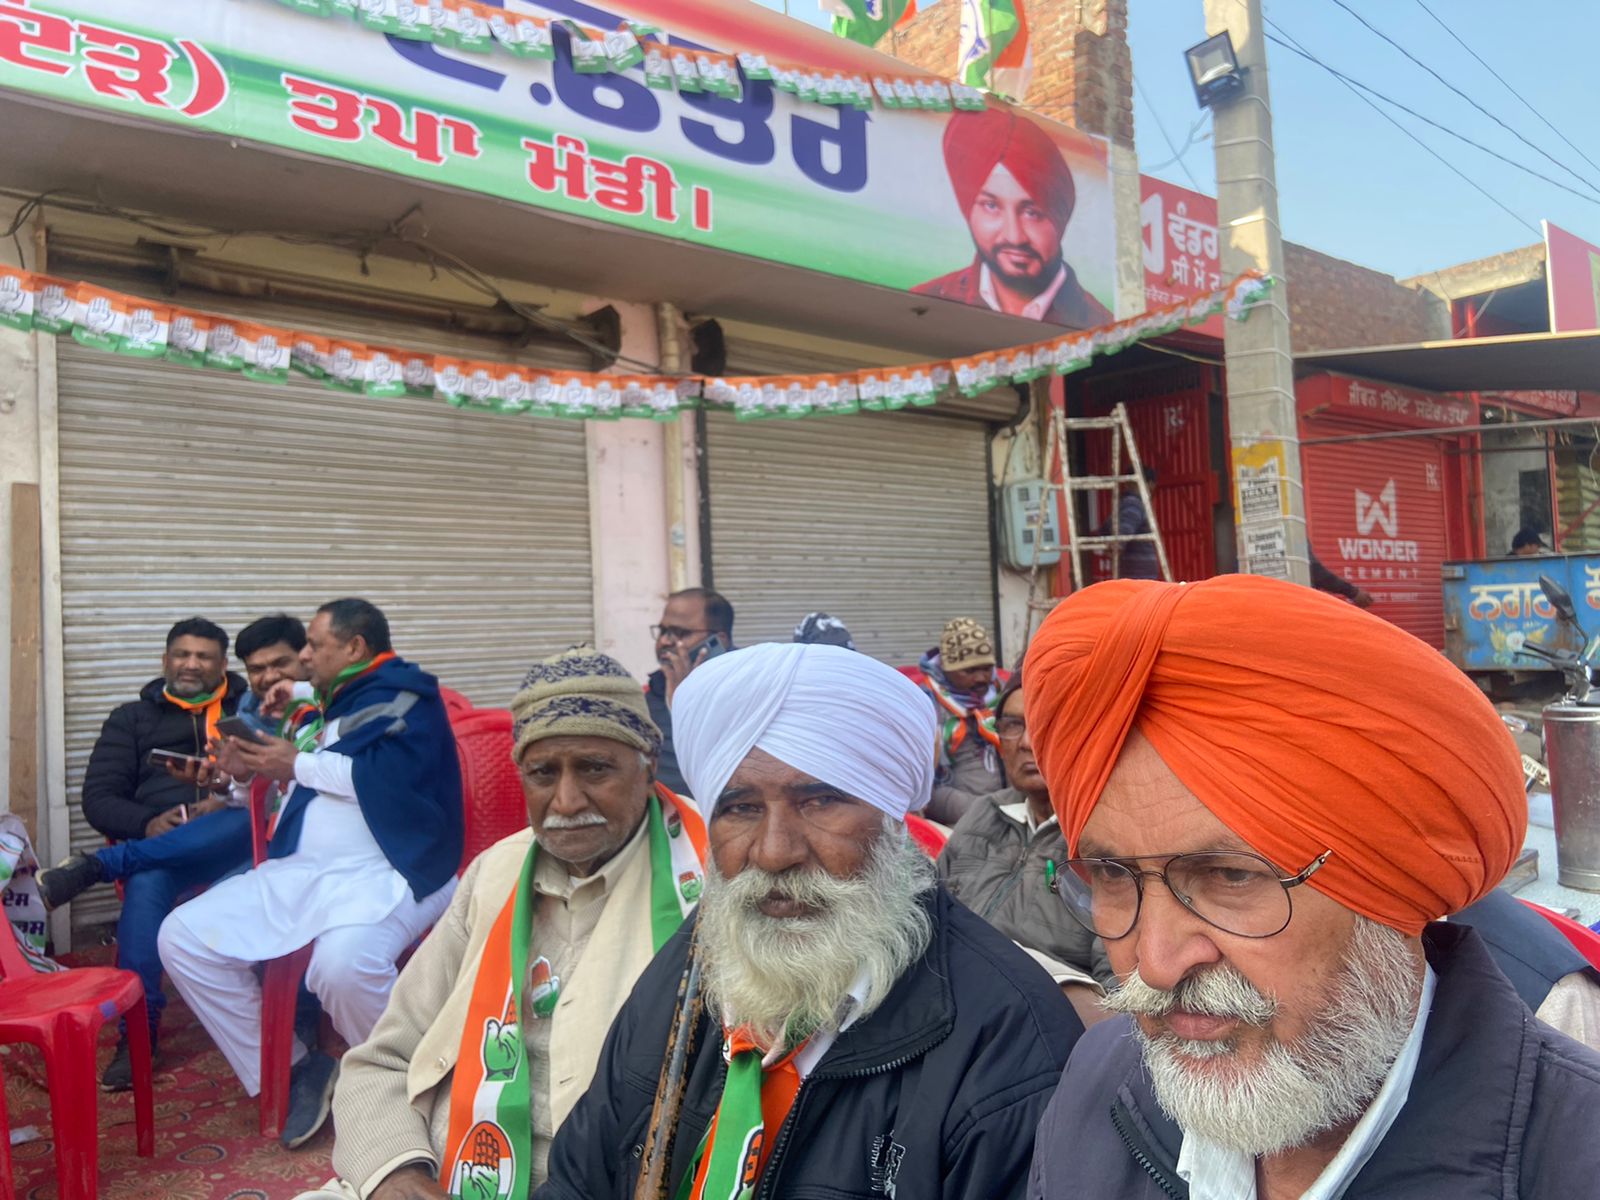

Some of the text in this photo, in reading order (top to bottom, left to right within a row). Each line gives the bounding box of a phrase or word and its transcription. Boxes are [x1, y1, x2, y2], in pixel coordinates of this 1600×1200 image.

[282, 74, 481, 164] ਤਪਾ
[1338, 537, 1418, 562] WONDER
[1343, 566, 1420, 580] CEMENT
